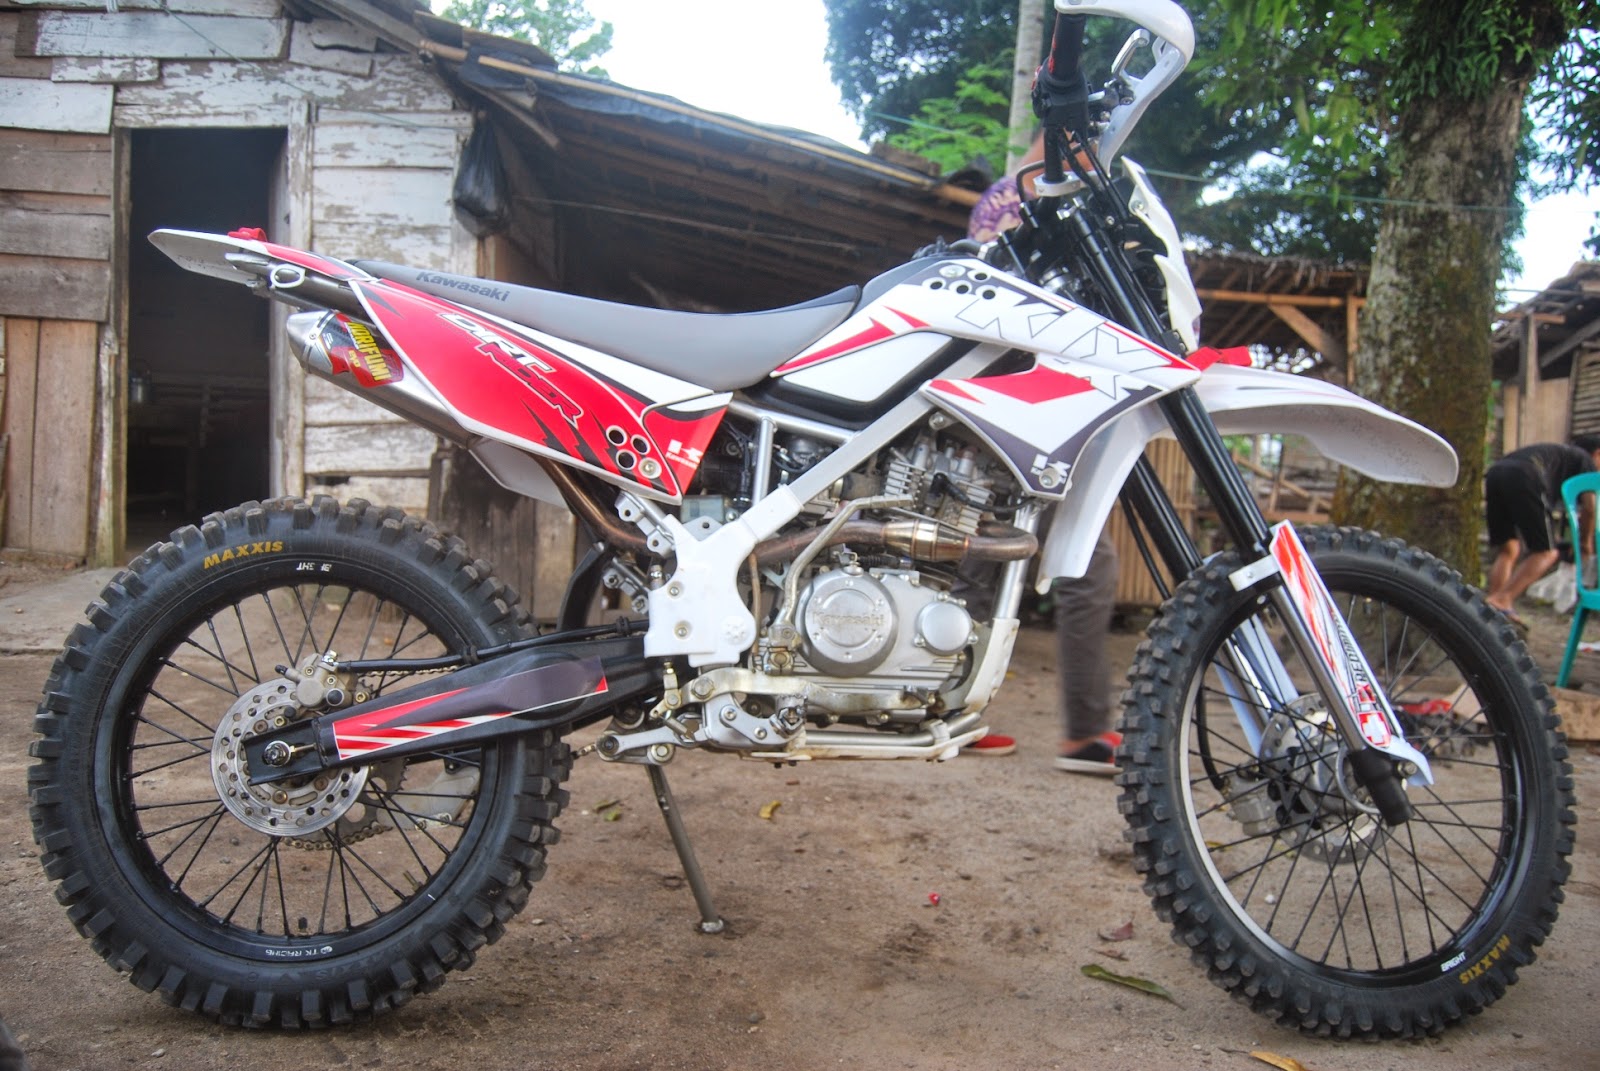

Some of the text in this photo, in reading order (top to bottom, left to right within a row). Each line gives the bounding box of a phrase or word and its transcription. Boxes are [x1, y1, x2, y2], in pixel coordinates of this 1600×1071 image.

[416, 271, 510, 302] Kawasaki
[438, 313, 556, 372] DIRT
[203, 541, 284, 569] MAXXIS
[1459, 934, 1512, 985] MAXXIS
